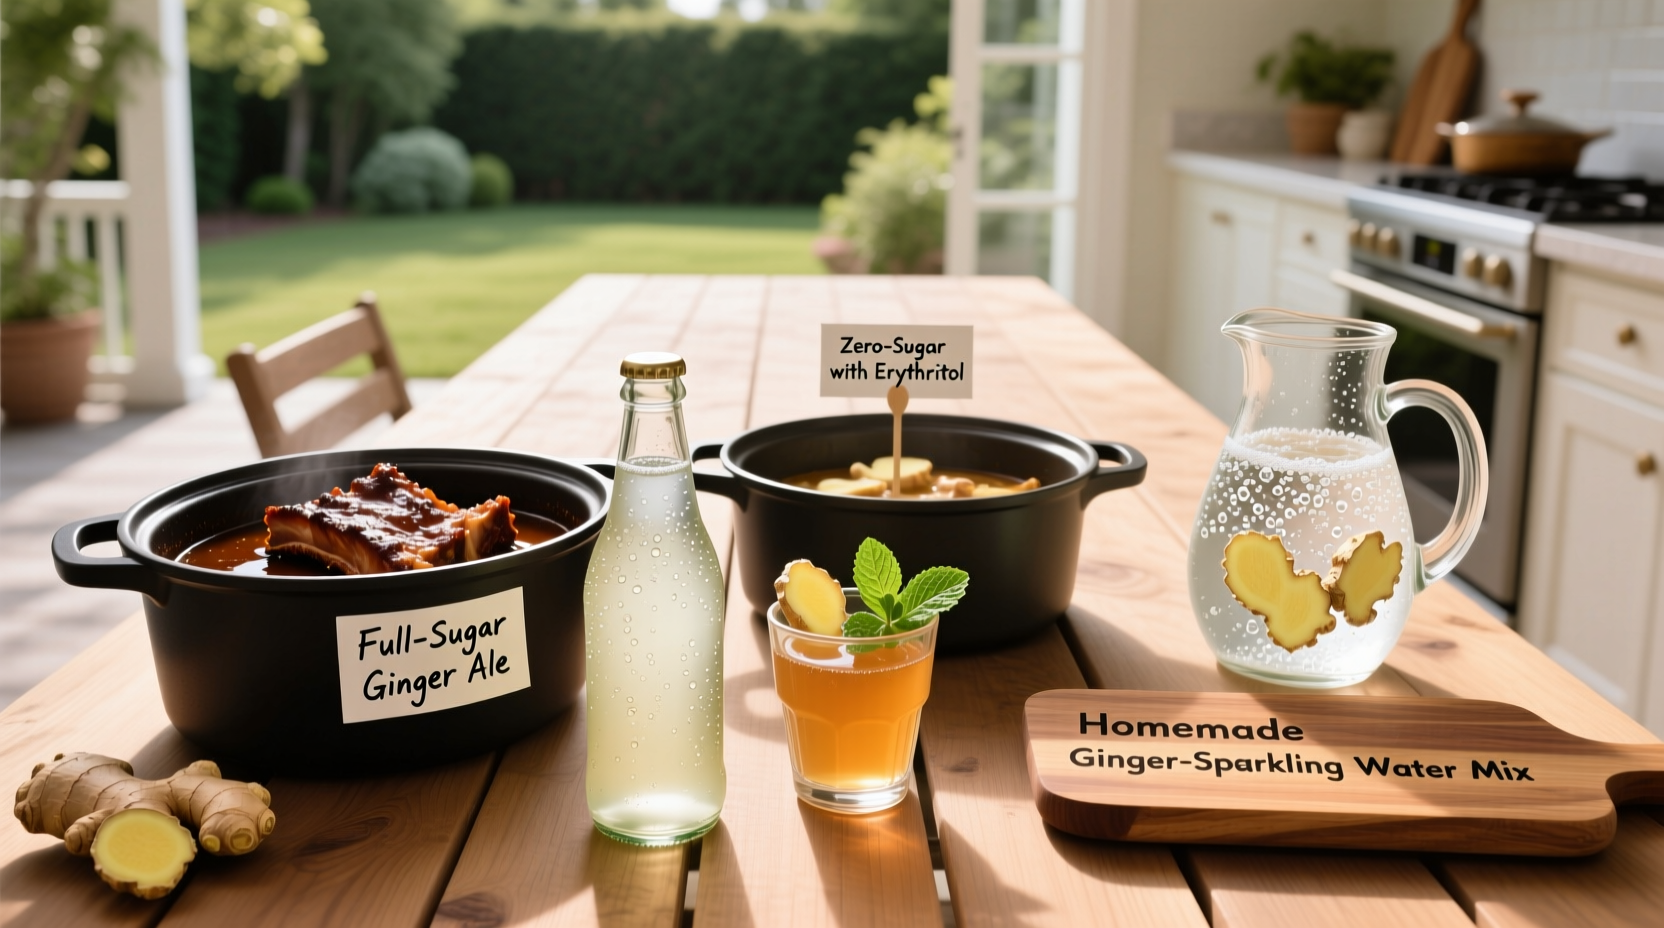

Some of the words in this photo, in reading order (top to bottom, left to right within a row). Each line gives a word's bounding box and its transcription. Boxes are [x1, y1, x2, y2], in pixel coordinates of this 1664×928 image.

[840, 336, 946, 361] Zero-Sugar
[830, 360, 868, 380] with
[875, 360, 964, 388] Erythritol
[358, 616, 507, 661] Full-Sugar
[363, 669, 457, 708] Ginger
[467, 648, 510, 684] Ale
[1079, 712, 1305, 741] Homemade
[1069, 747, 1344, 782] Ginger-Sparkling
[1353, 756, 1457, 779] Water
[1471, 760, 1535, 782] Mix
